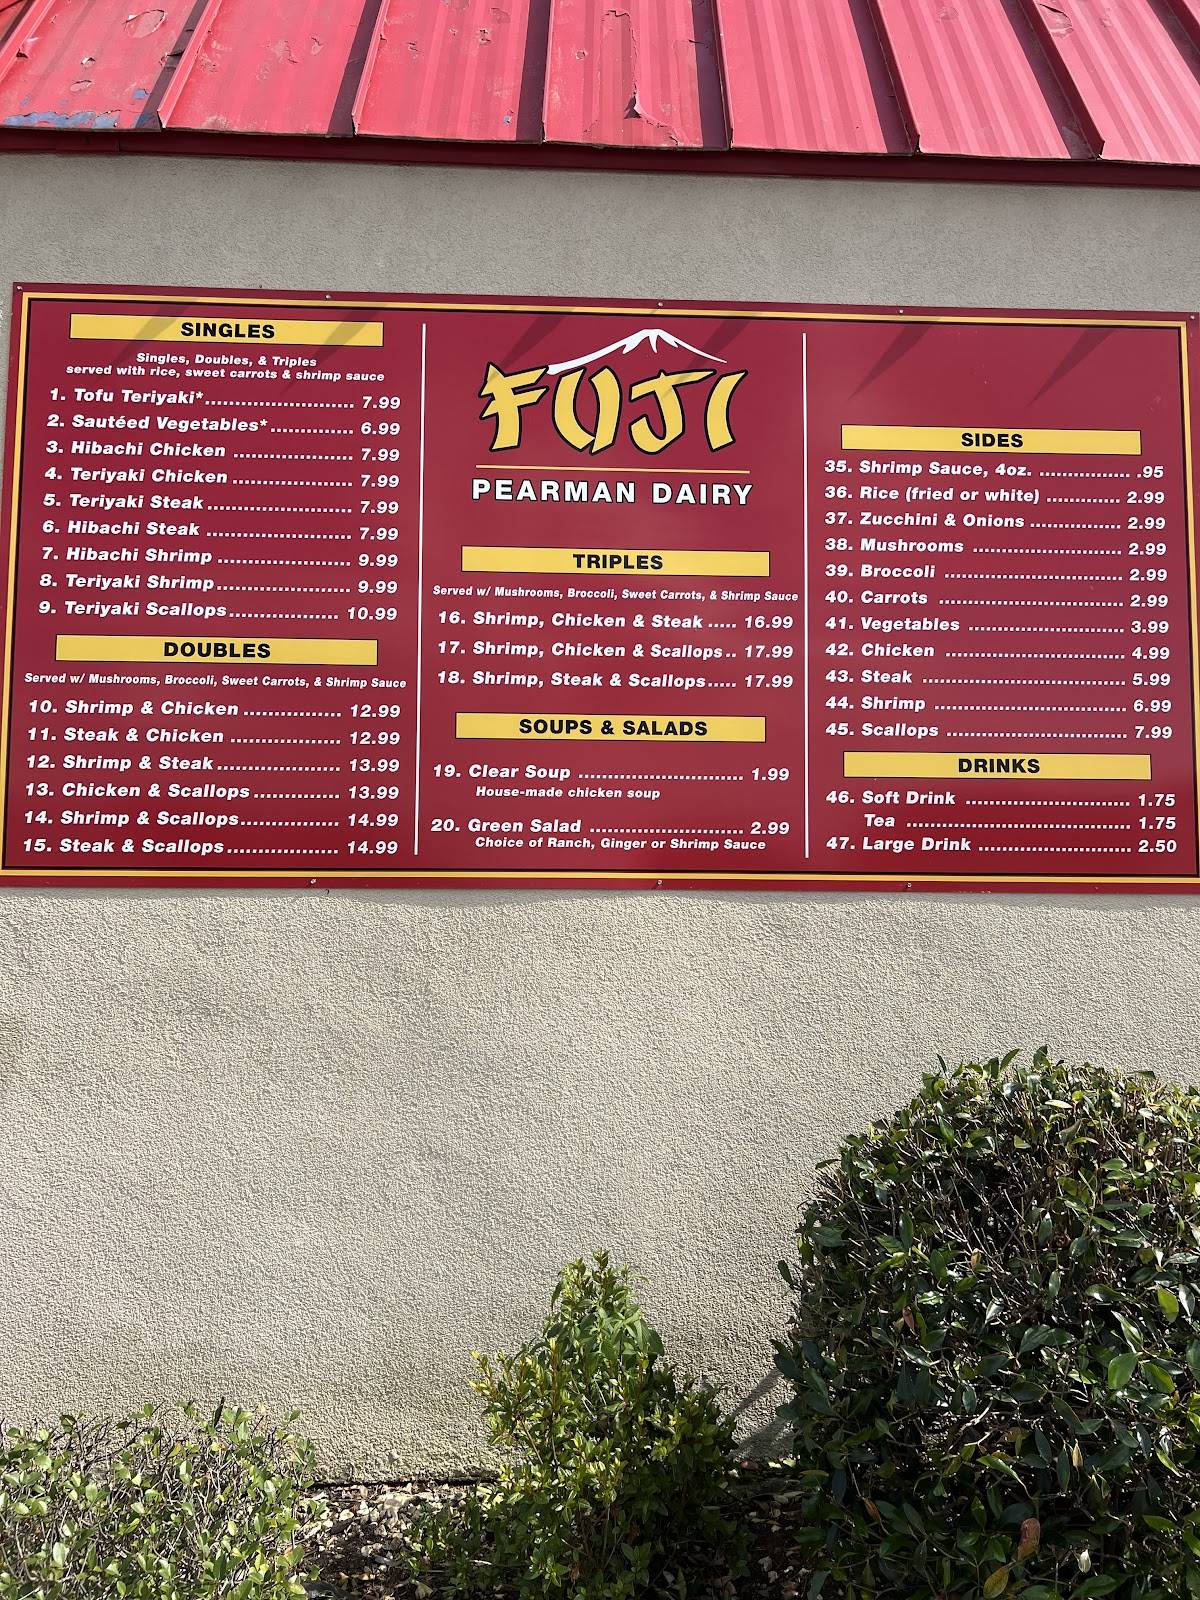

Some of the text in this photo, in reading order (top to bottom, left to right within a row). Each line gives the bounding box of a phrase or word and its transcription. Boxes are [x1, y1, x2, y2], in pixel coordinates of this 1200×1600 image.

[181, 322, 275, 339] SINGLES
[136, 353, 317, 368] Singles, Doubles, & Triples
[66, 365, 384, 382] served with rice, sweet carrots & shrimp sauce
[50, 388, 65, 400] 1.
[74, 388, 114, 402] Tofu
[363, 396, 400, 409] 7.99
[478, 361, 748, 455] FUJI
[47, 414, 64, 427] 2.
[72, 414, 150, 429] Sautéed
[361, 422, 400, 435] 6.99
[961, 433, 1023, 448] SIDES
[46, 440, 400, 461] 3. Hibachi Chicken 7.99
[824, 460, 1163, 478] 35. Shrimp Sauce, 4oz. .95
[473, 479, 752, 504] PEARMAN DAIRY
[825, 486, 1164, 504] 36. Rice (fried or white) 2.99
[825, 512, 1165, 529] 37. Zucchini & Onions 2.99
[43, 520, 398, 540] 6. Hibachi Steak 7.99
[825, 538, 1166, 555] 38. Mushrooms 2.99
[573, 554, 663, 570] TRIPLES
[433, 585, 798, 602] Served w/ Mushrooms, Broccoli, Sweet Carrots, & Shrimp Sauce
[825, 590, 1168, 607] 40. Carrots 2.99
[39, 601, 397, 620] 9. Teriyaki Scallops 10.99
[439, 611, 793, 628] 16. Shrimp, Chicken & Steak 16.99
[825, 617, 1169, 633] 41. Vegetables 3.99
[164, 642, 271, 658] DOUBLES
[438, 641, 793, 660] 17. Shrimp, Chicken & Scallops 17.99
[825, 643, 1170, 659] 42. Chicken 4.99
[24, 673, 406, 689] Served w/ Mushrooms, Broccoli, Sweet Carrots, & Shrimp Sauce
[825, 669, 1170, 686] 43. Steak 5.99
[29, 700, 400, 718] 10. Shrimp & Chicken 12.99
[519, 719, 707, 736] SOUPS & SALADS
[826, 723, 1172, 739] 45. Scallops 7.99
[27, 755, 399, 772] 12. Shrimp & Steak 13.99
[958, 758, 1040, 773] DRINKS
[434, 764, 789, 781] 19. Clear Soup 1.99
[476, 786, 660, 800] House-made chicken soup
[826, 790, 1175, 806] 46. Soft Drink 1.75
[431, 818, 789, 834] 20. Green Salad 2.99
[864, 814, 1176, 829] Tea 1.75
[24, 838, 398, 856] 15. Steak & Scallops 14.99
[475, 837, 524, 847] Choice
[529, 837, 543, 847] of
[547, 837, 595, 850] Ranch,
[601, 838, 647, 850] Ginger
[670, 838, 719, 851] Shrimp
[724, 839, 766, 849] Sauce
[826, 837, 1177, 853] 47. Large Drink 2.50
